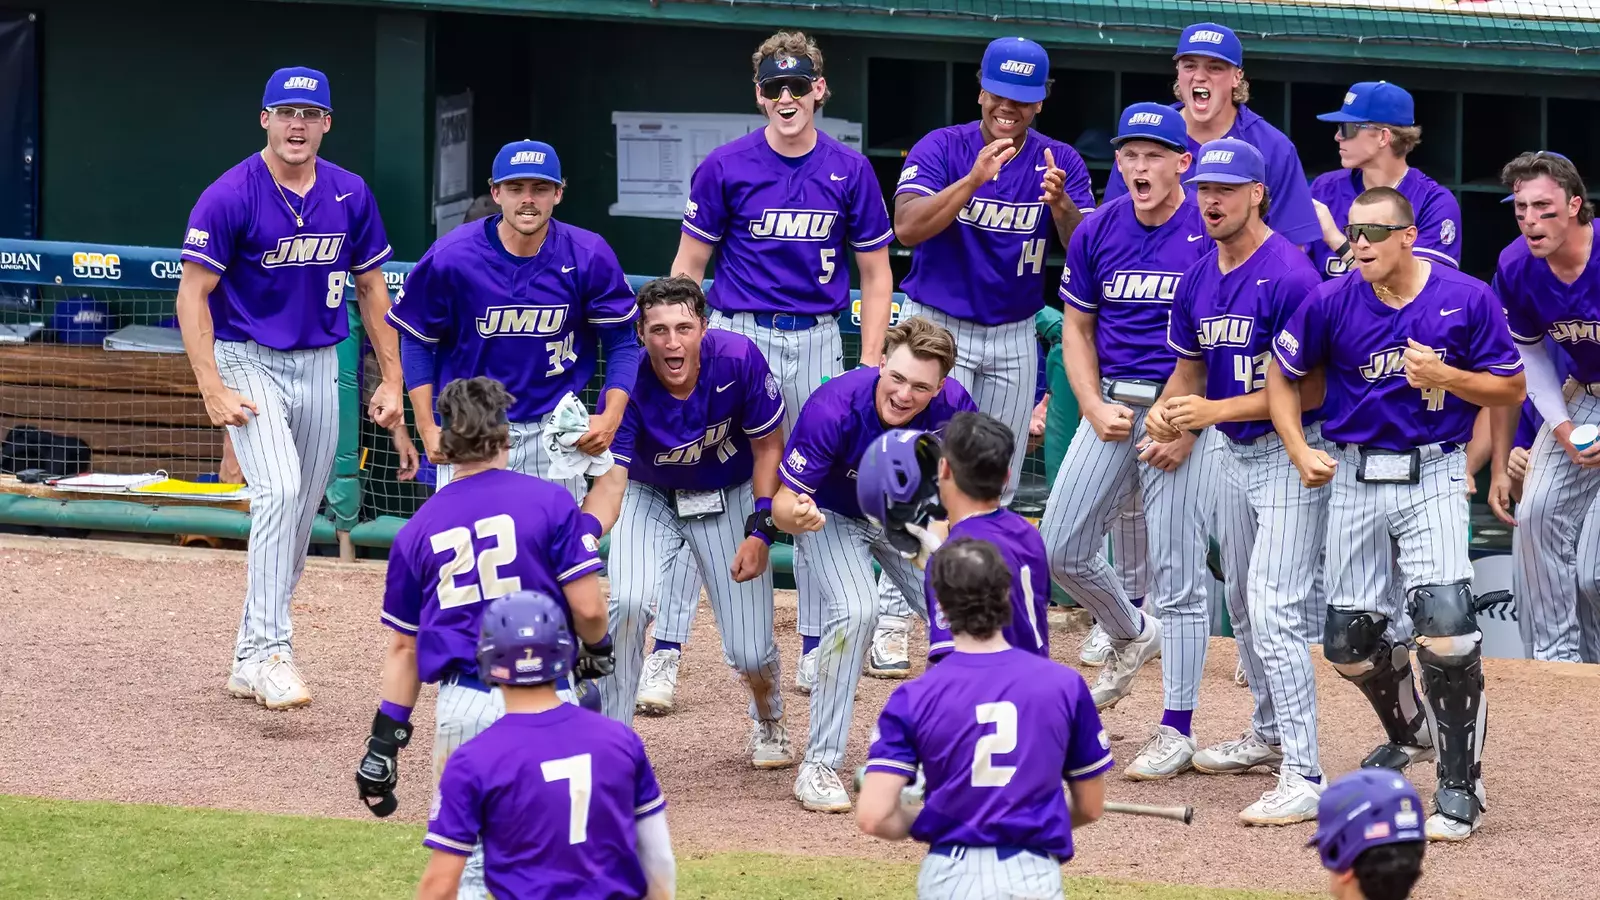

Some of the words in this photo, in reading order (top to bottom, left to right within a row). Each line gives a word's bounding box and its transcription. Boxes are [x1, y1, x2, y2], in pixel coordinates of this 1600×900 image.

[1189, 30, 1224, 44] JMU
[284, 77, 318, 91] JMU
[1000, 59, 1035, 76] JMU
[1128, 112, 1163, 126] JMU
[510, 151, 546, 165] JMU
[1201, 150, 1234, 164] JMU
[750, 209, 838, 241] JMU
[957, 197, 1044, 233] JMU
[73, 252, 122, 279] SBC
[261, 233, 346, 269] JMU
[819, 248, 836, 284] 5
[1016, 238, 1046, 276] 14
[326, 271, 346, 308] 8
[476, 304, 569, 338] JMU
[1197, 314, 1254, 349] JMU
[1548, 320, 1600, 344] JM
[545, 331, 578, 377] 34
[1234, 350, 1272, 393] 43
[654, 418, 731, 465] JMU
[430, 513, 523, 610] 22
[971, 701, 1018, 787] 2
[540, 753, 592, 845] 7
